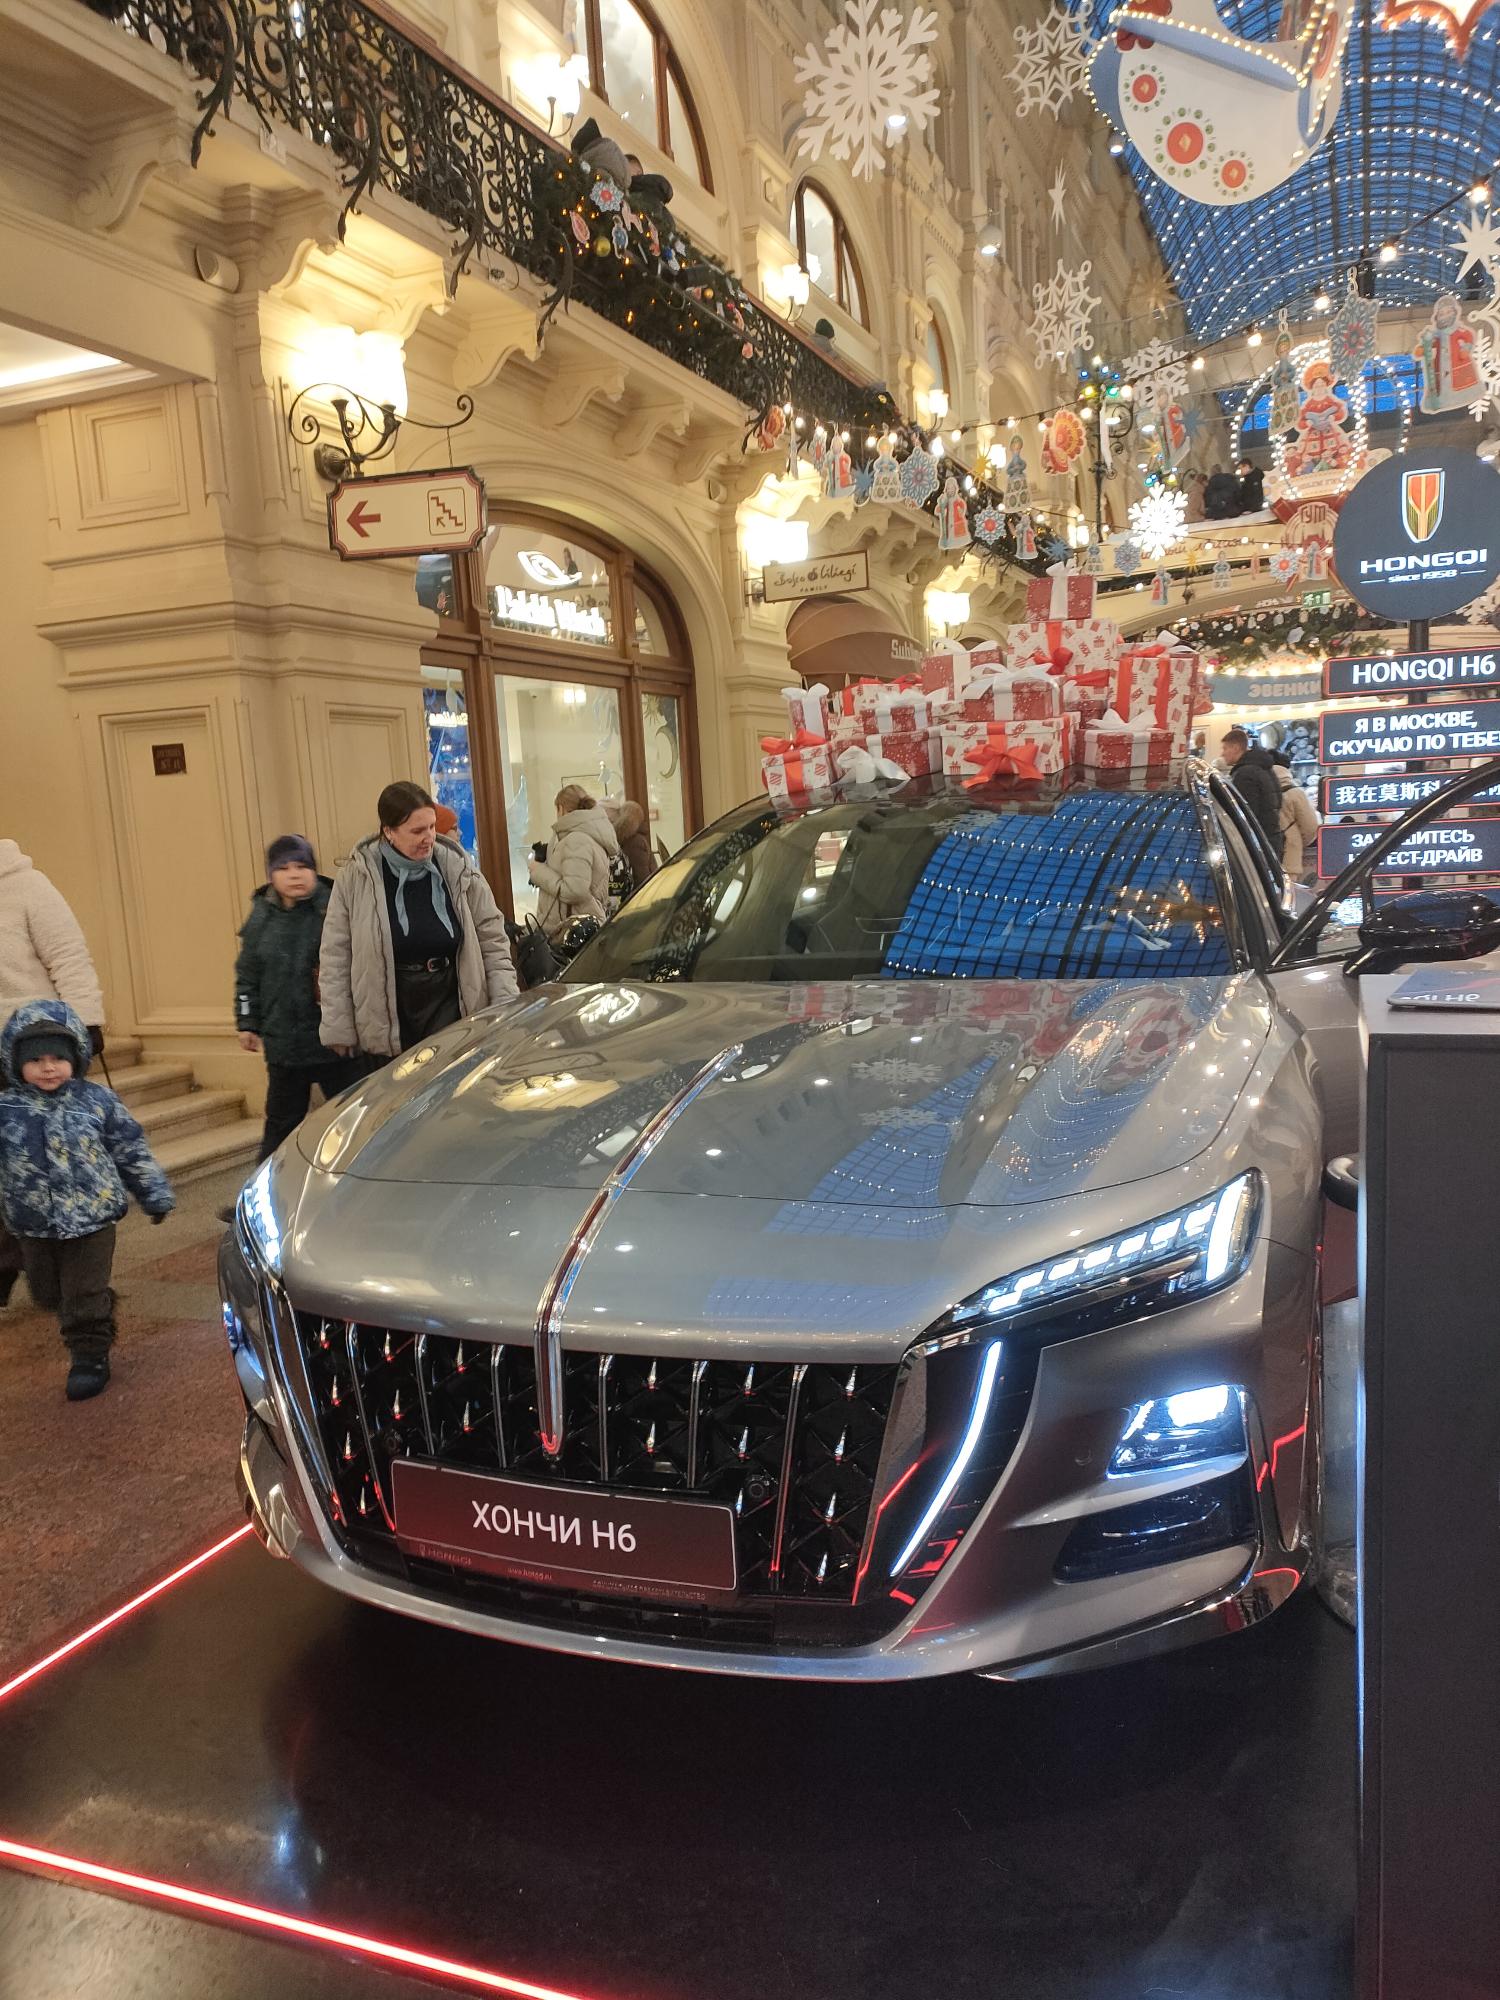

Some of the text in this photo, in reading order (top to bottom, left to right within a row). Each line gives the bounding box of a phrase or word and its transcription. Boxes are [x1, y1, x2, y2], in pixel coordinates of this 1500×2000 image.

[1301, 504, 1326, 523] ГУМ
[1360, 549, 1487, 574] HONGQI
[1388, 569, 1457, 583] since 1958
[1352, 654, 1496, 685] HONGQI H6
[1355, 710, 1477, 734] Я В МОСКВЕ,
[1329, 731, 1500, 756] СКУЧАЮ ПО ТЕБЕ
[1351, 829, 1475, 848] ЗАШИТЕСЬ
[1379, 846, 1483, 867] ЕСТ-ДРАЙВ
[471, 1500, 581, 1546] ХОНЧИ
